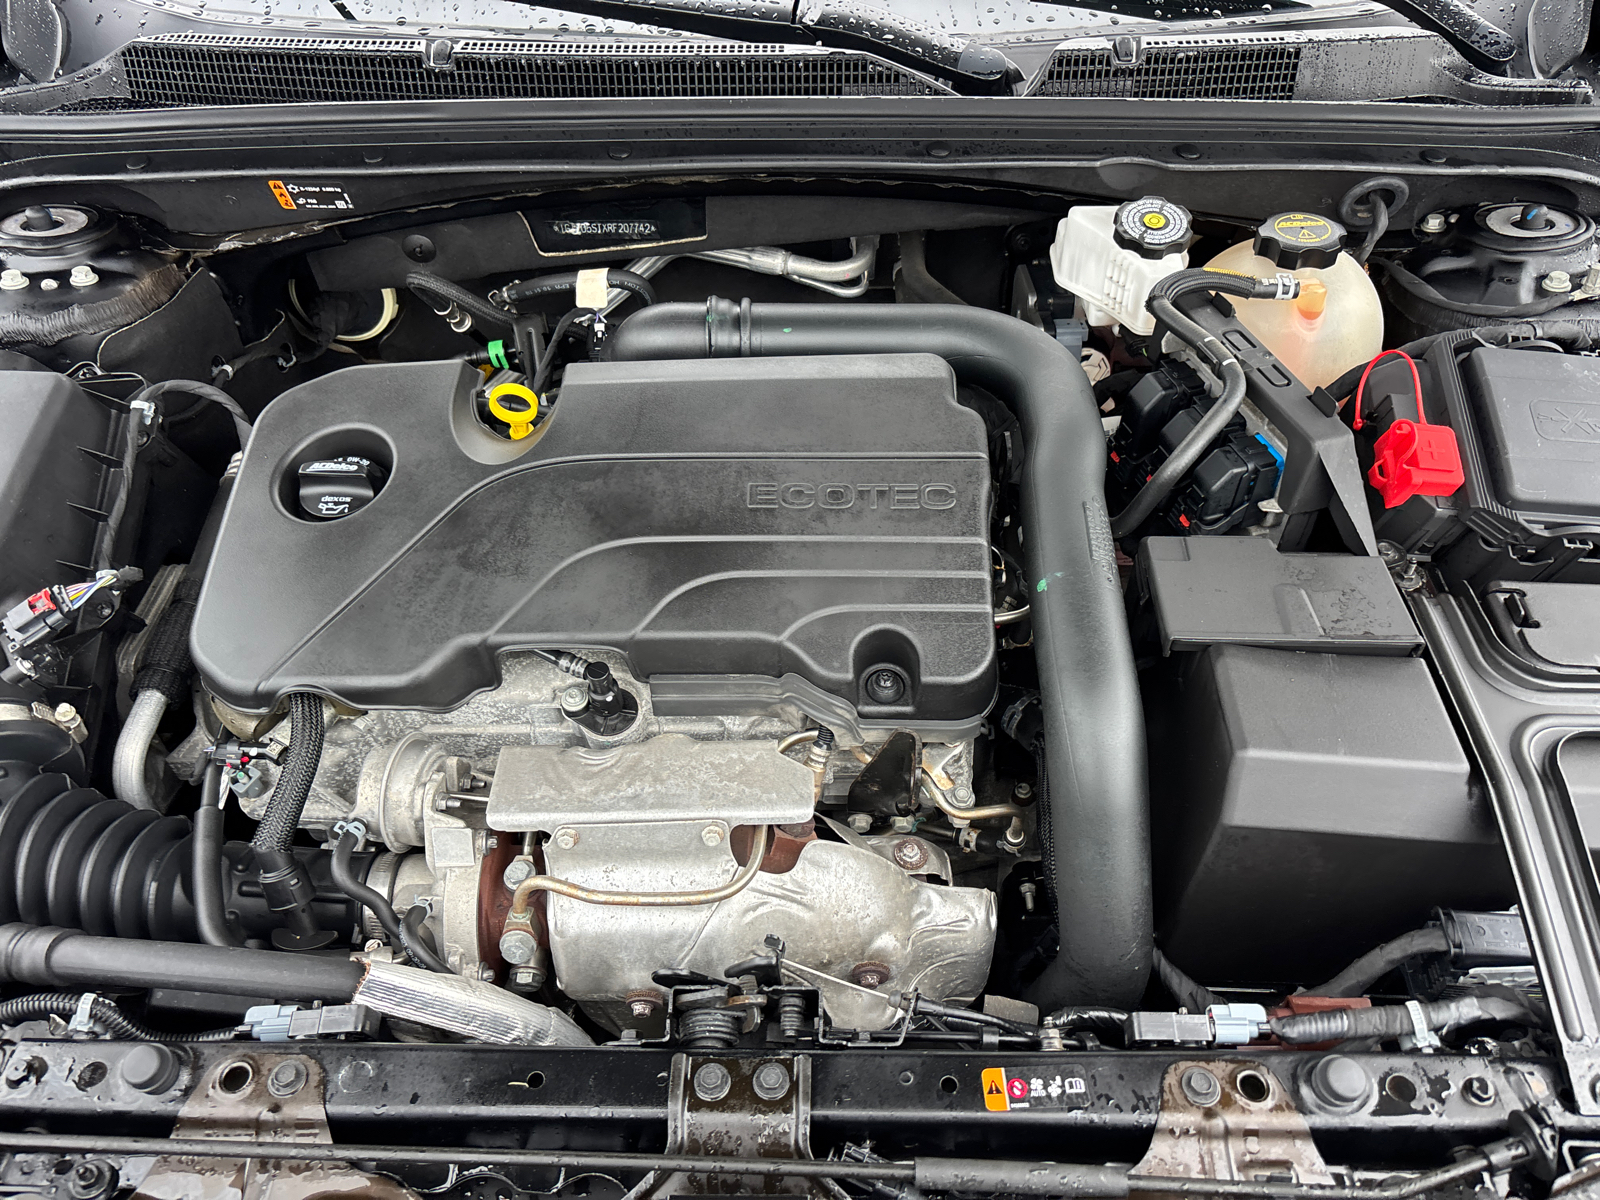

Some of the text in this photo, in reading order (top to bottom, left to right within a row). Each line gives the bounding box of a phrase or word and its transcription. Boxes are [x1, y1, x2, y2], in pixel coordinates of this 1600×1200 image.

[346, 457, 370, 466] 0W-20
[306, 463, 358, 471] ACDelco
[747, 482, 957, 509] ECOTEC
[1030, 1089, 1047, 1097] AUTO
